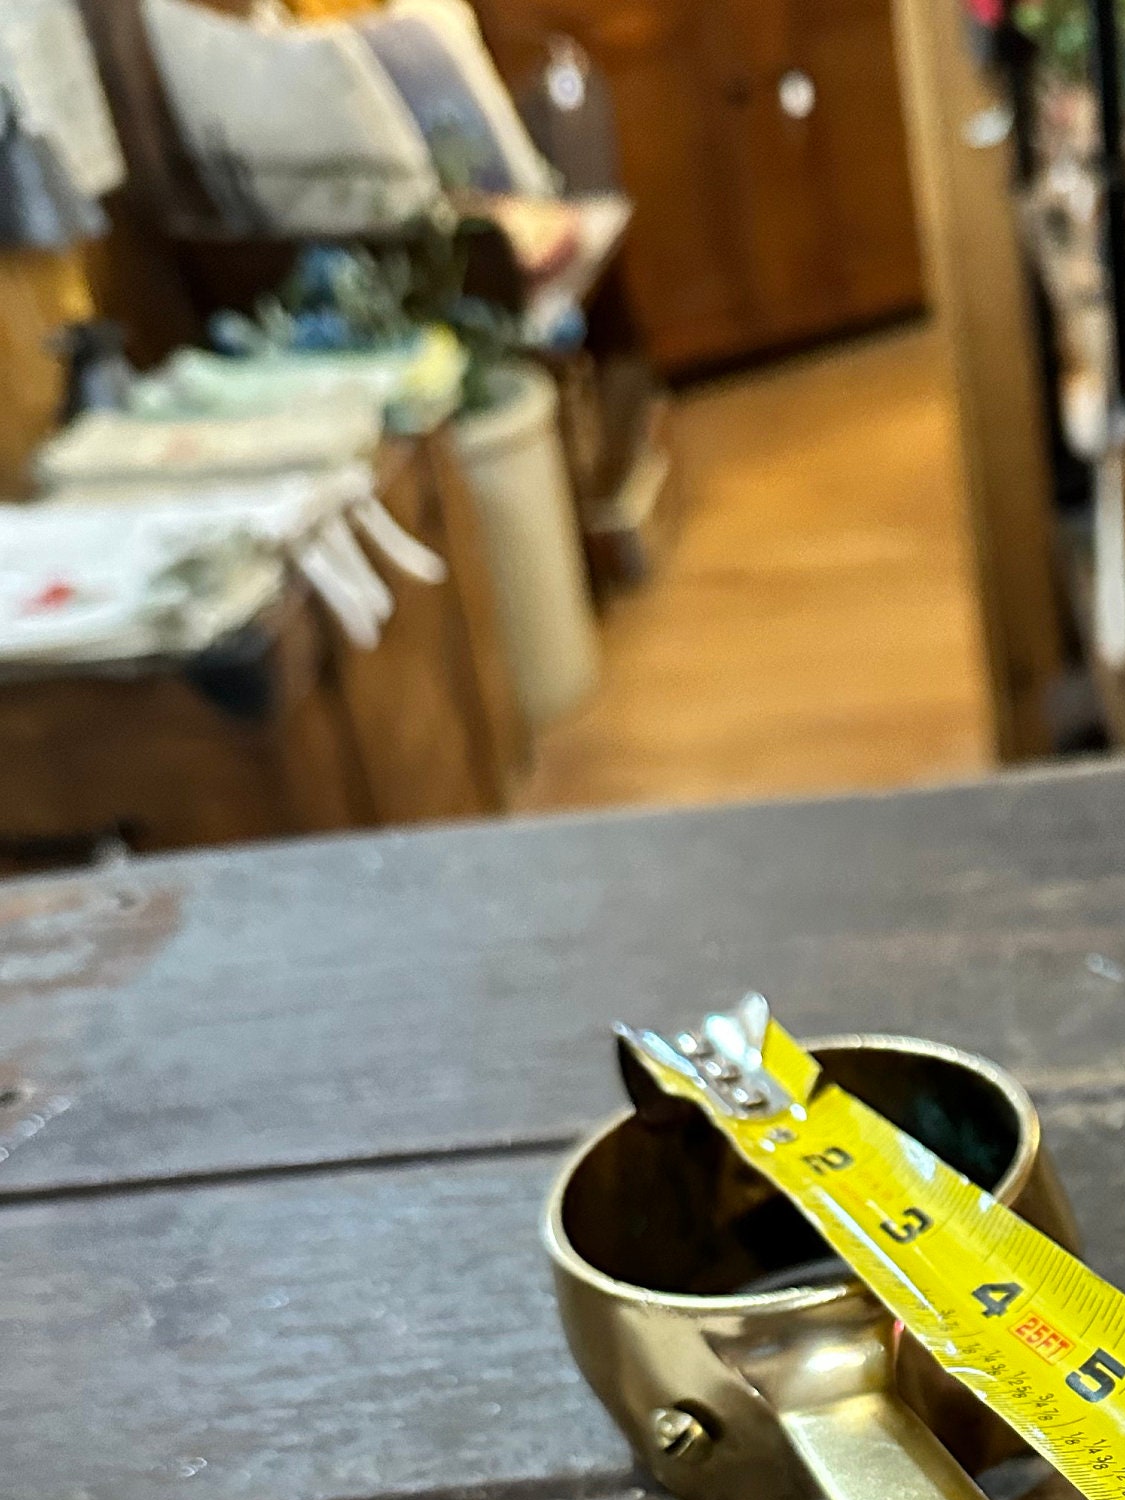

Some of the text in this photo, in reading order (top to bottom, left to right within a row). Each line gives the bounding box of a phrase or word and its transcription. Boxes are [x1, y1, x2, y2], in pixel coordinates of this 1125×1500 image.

[803, 1147, 853, 1176] 2
[880, 1207, 934, 1245] 3
[971, 1282, 1024, 1318] 4
[1015, 1317, 1070, 1359] 25FT
